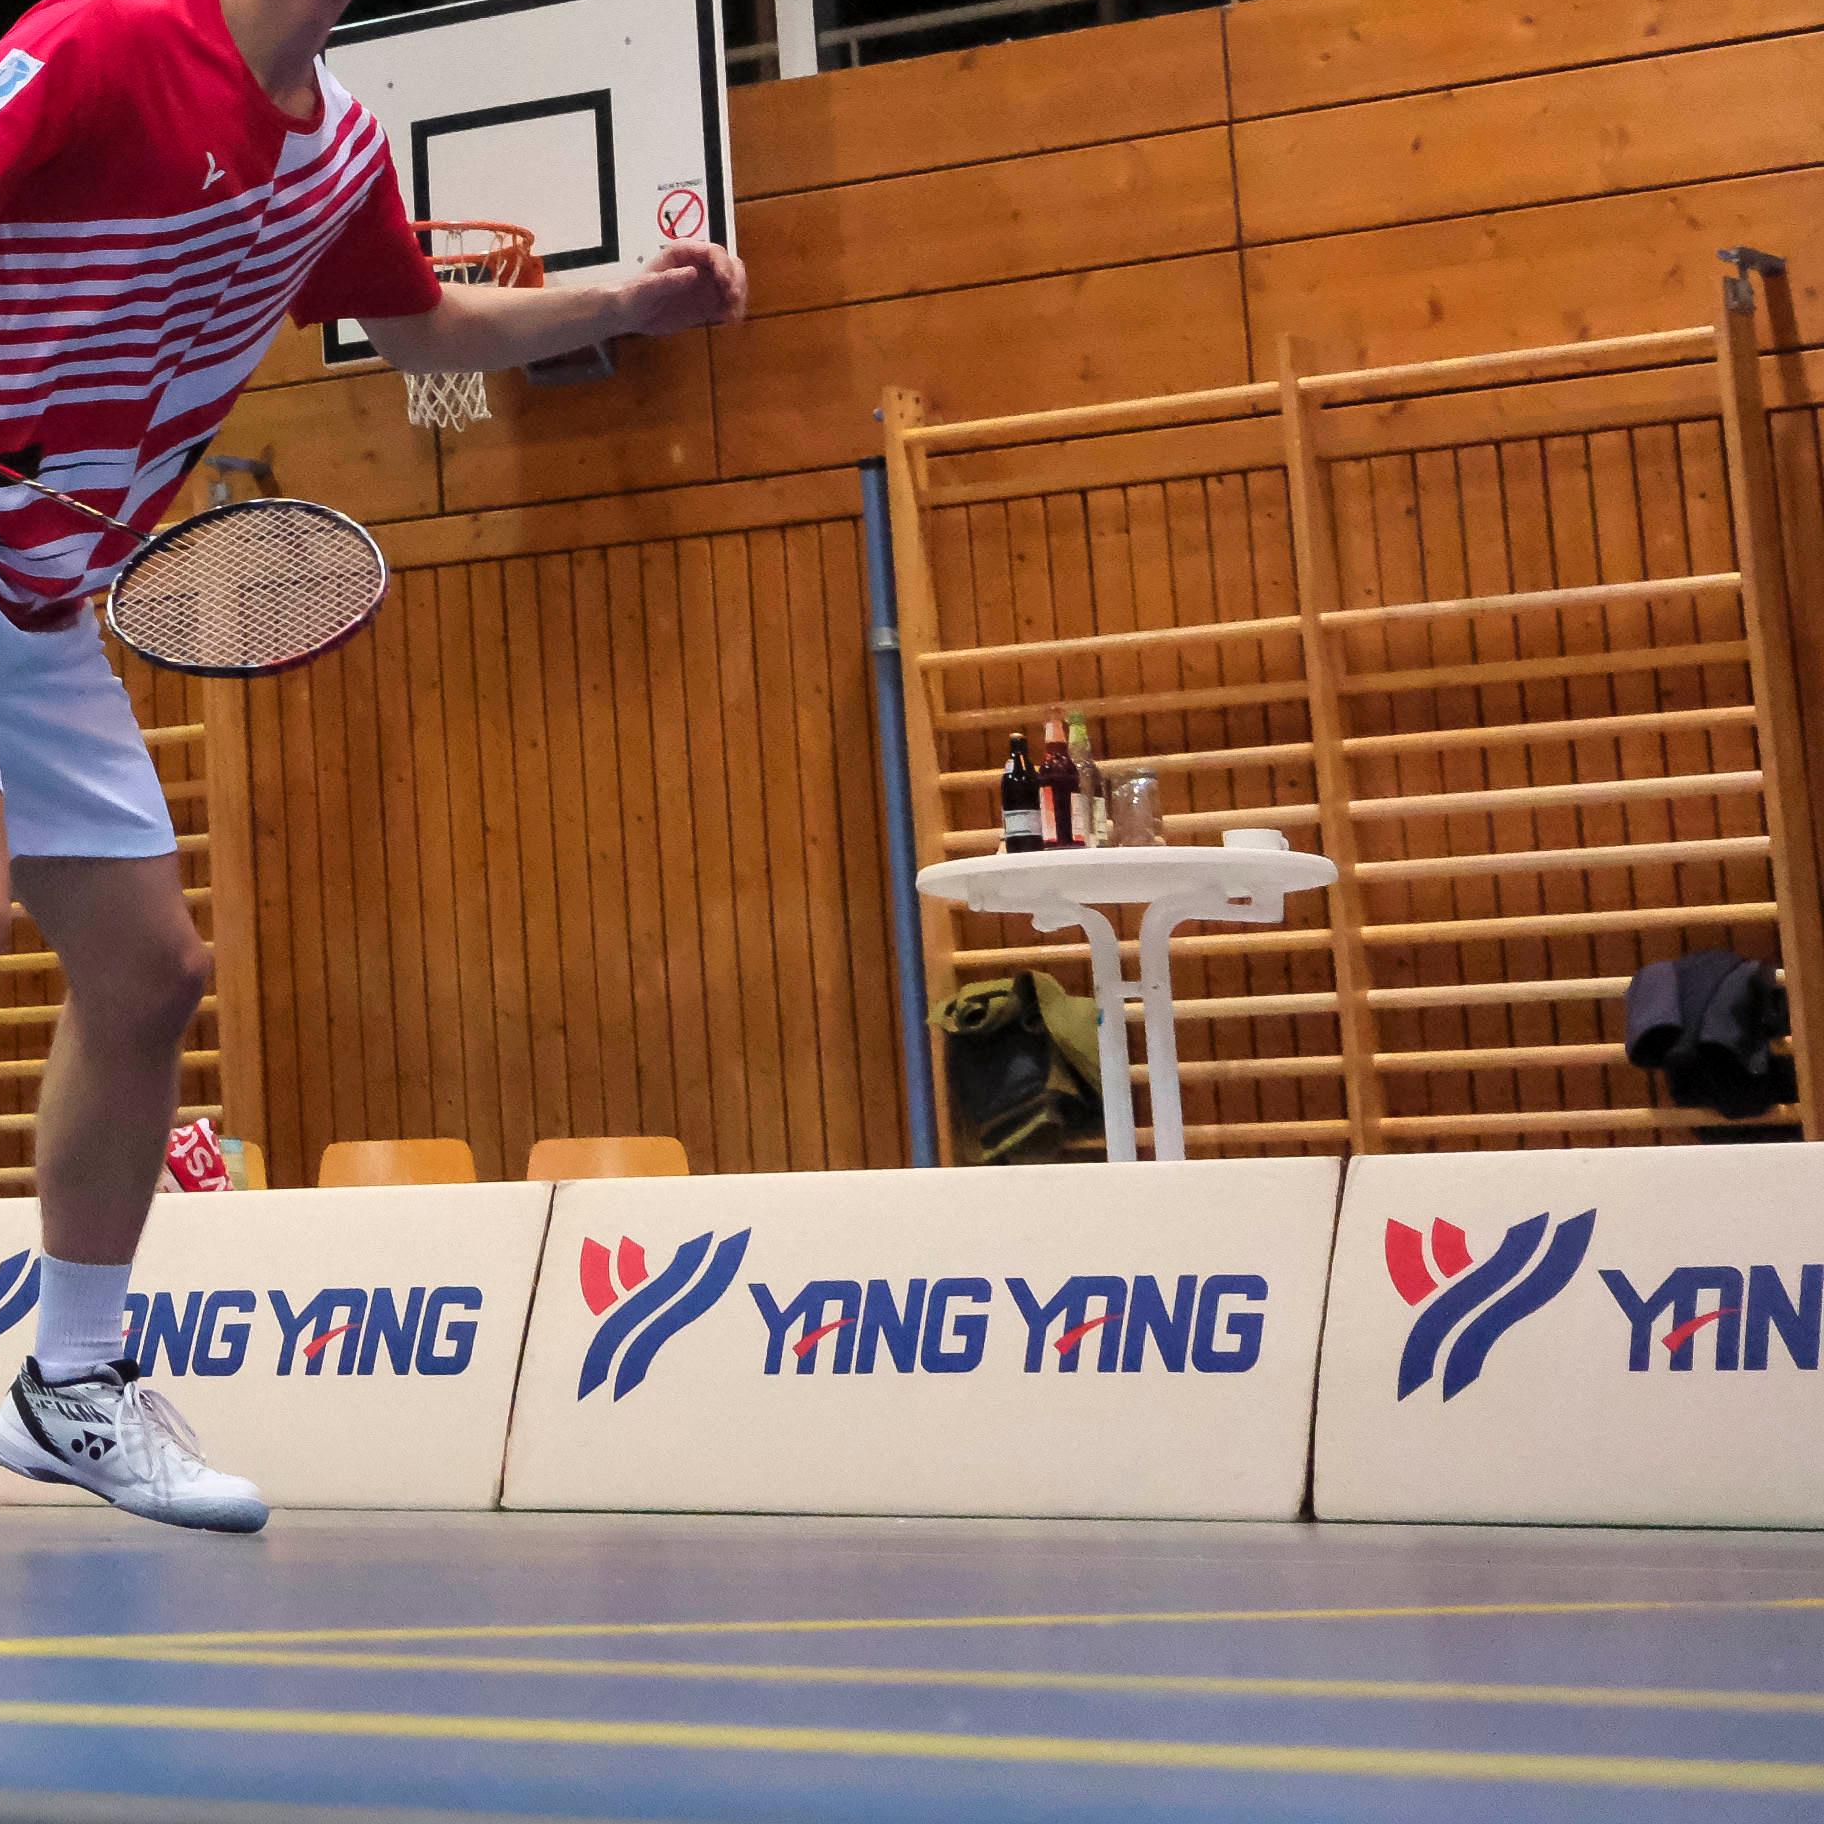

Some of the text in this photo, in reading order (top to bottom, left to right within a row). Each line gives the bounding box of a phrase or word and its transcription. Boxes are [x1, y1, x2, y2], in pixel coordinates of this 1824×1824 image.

[268, 1285, 483, 1377] YANG
[748, 1274, 1269, 1375] YANG YANG
